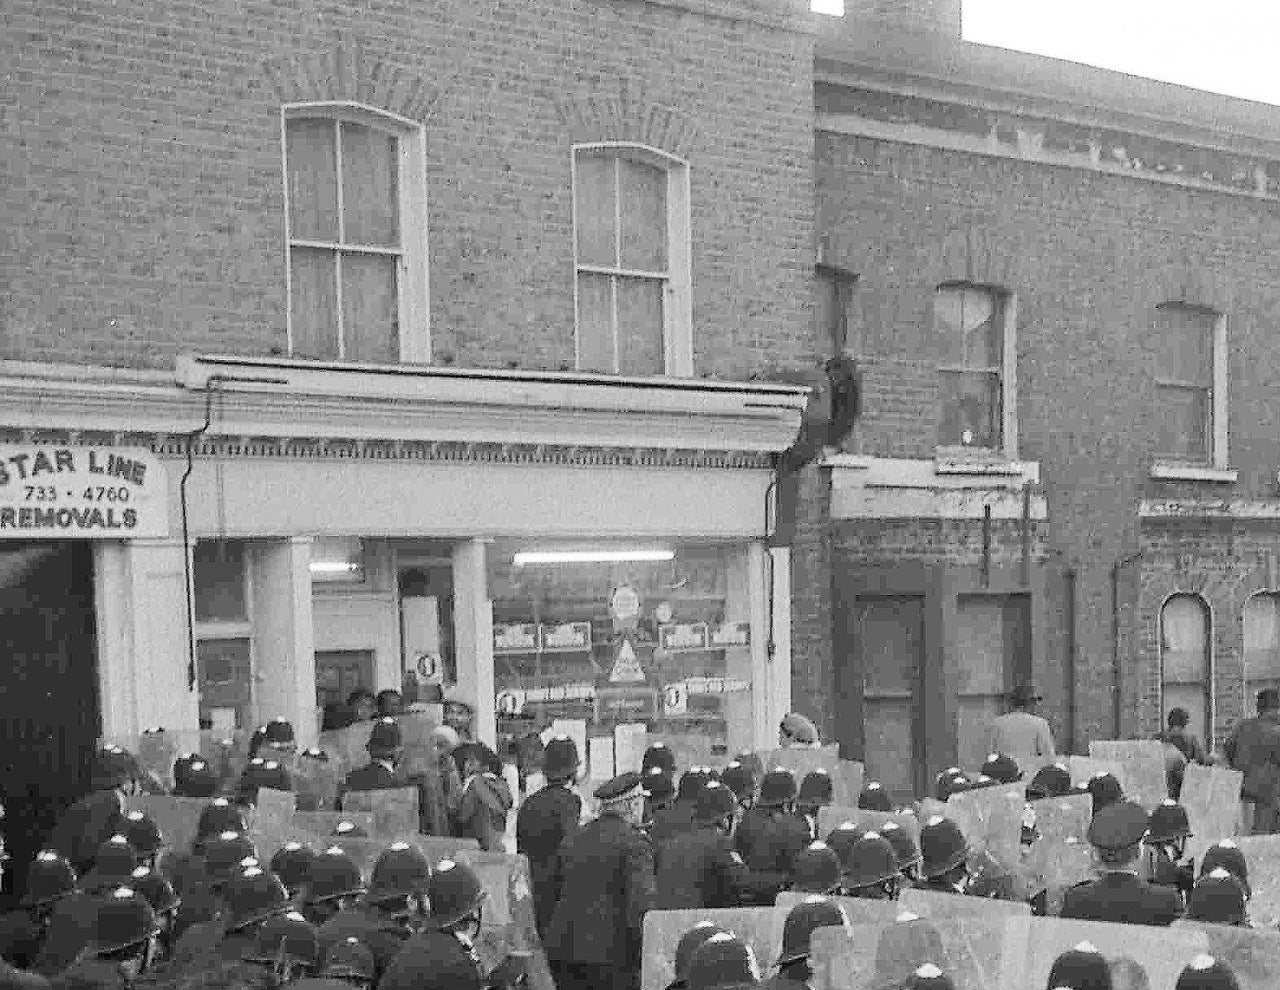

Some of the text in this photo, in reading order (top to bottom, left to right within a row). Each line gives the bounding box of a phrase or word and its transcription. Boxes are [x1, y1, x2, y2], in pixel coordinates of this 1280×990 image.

[89, 450, 147, 486] LINE
[83, 486, 129, 502] 4760
[0, 507, 137, 528] REMOVALS
